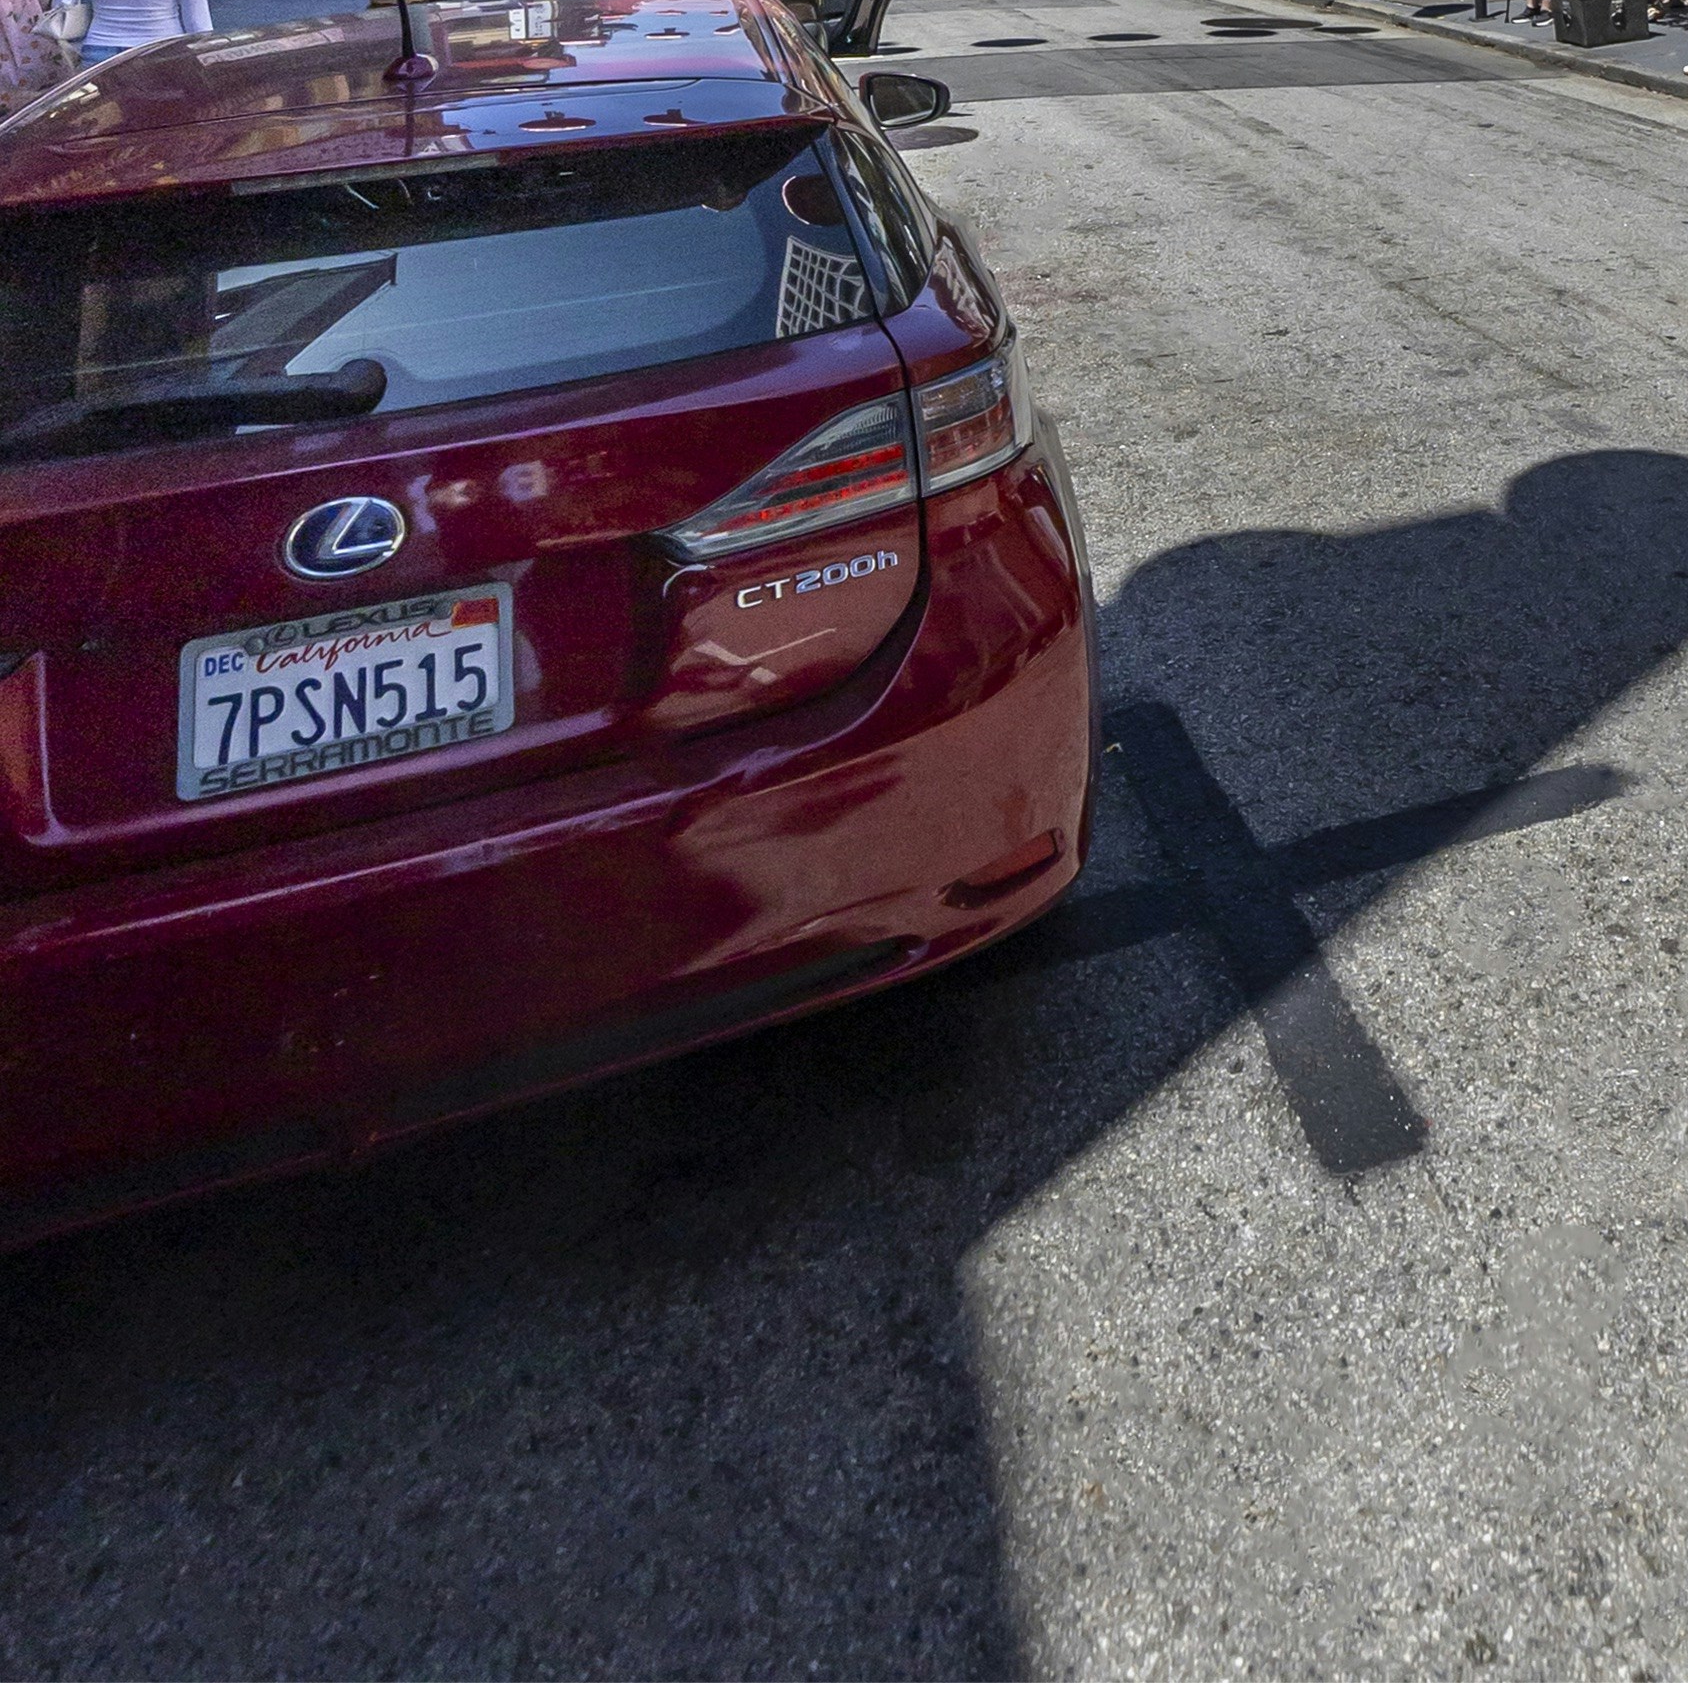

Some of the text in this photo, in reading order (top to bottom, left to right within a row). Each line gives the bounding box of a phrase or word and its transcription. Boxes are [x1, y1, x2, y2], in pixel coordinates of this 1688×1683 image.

[204, 621, 453, 677] DEC California
[301, 599, 436, 638] LEXUS
[207, 643, 488, 765] 7PSN515
[200, 709, 496, 794] SERRAMONTE
